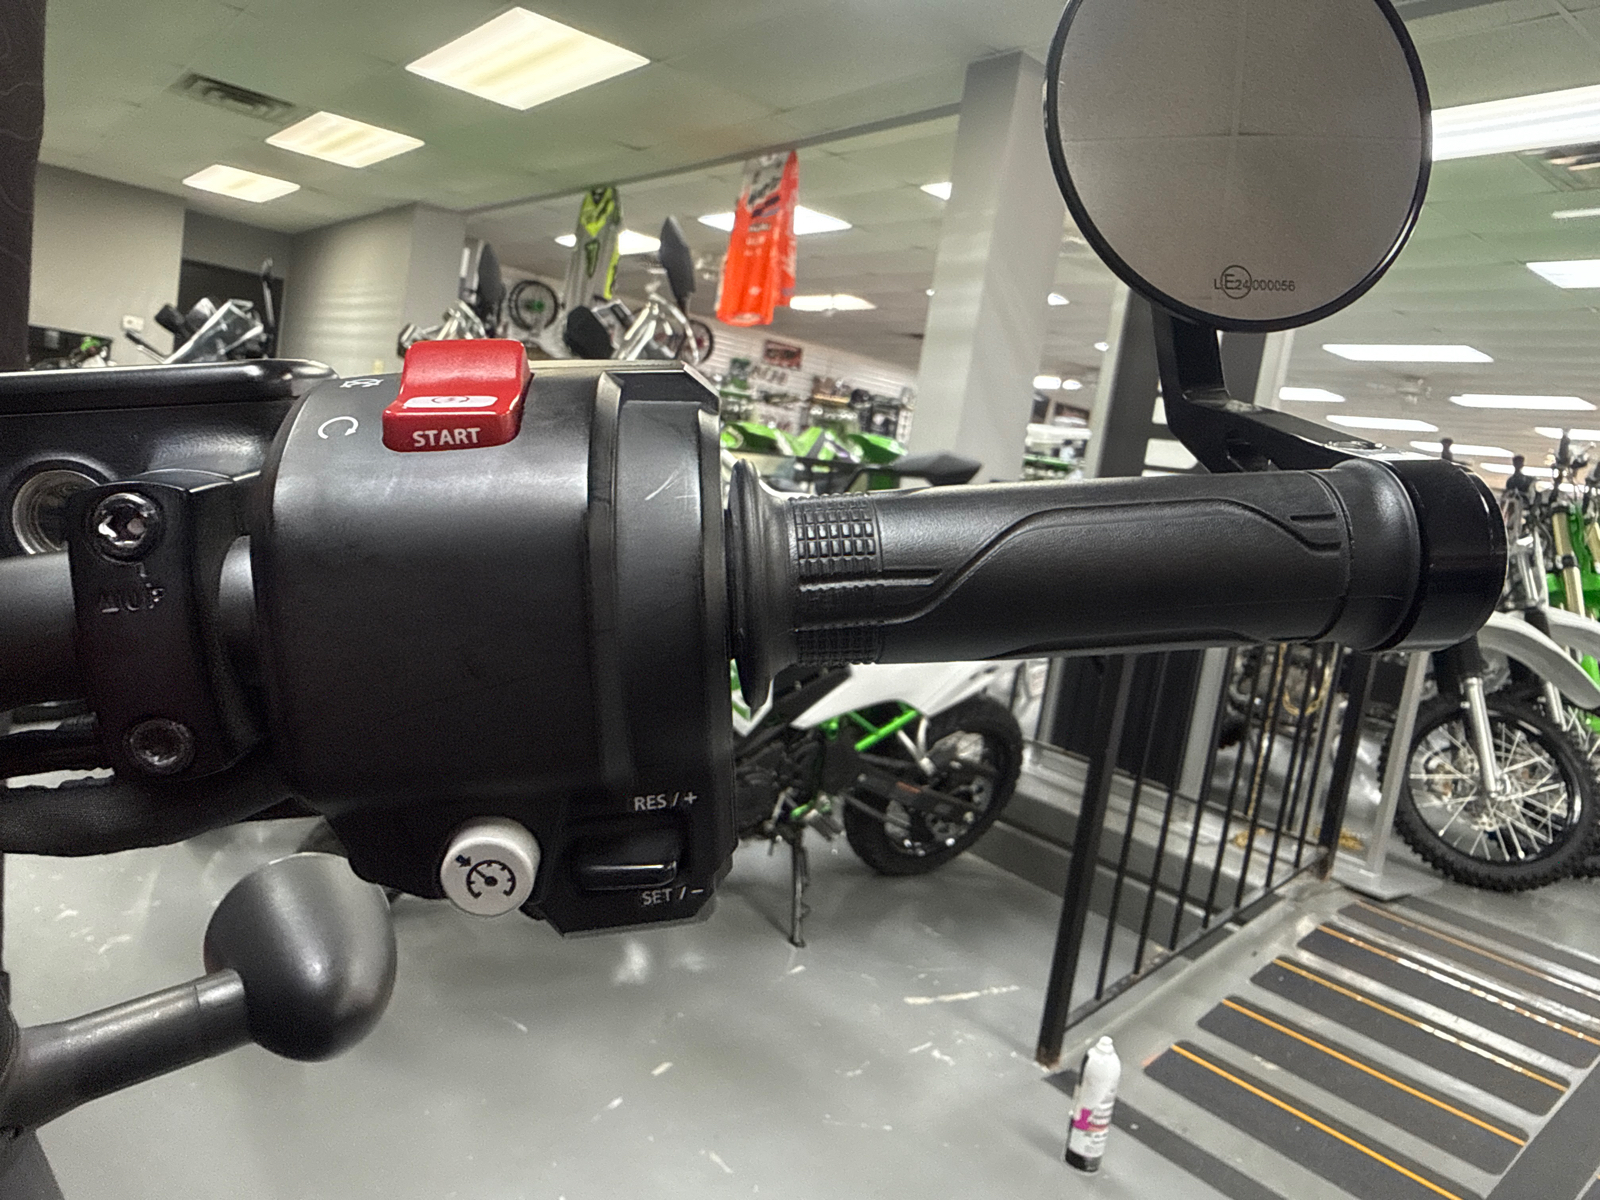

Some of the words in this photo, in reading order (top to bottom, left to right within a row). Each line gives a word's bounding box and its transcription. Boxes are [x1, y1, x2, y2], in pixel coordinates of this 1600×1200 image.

[412, 427, 481, 447] START
[634, 793, 667, 811] RES
[641, 888, 673, 905] SET
